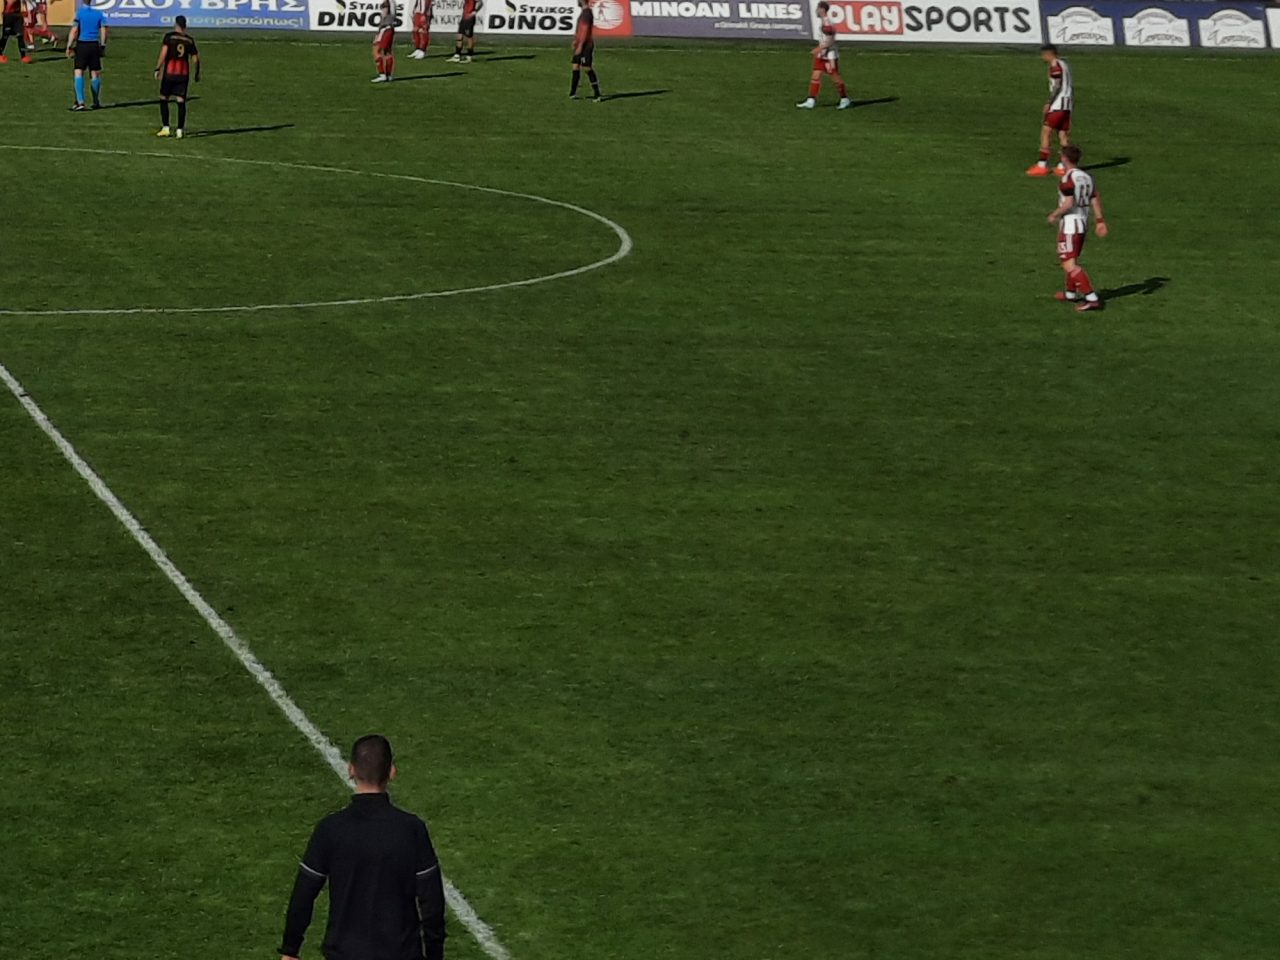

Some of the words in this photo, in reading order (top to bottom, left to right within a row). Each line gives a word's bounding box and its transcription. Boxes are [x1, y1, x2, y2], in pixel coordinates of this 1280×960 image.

[519, 3, 574, 15] STAIKOS
[630, 1, 731, 18] MINOAN
[738, 2, 803, 20] LINES
[488, 14, 574, 31] DINOS
[830, 5, 901, 31] PLAY
[904, 5, 1031, 33] SPORTS
[176, 43, 185, 58] 9
